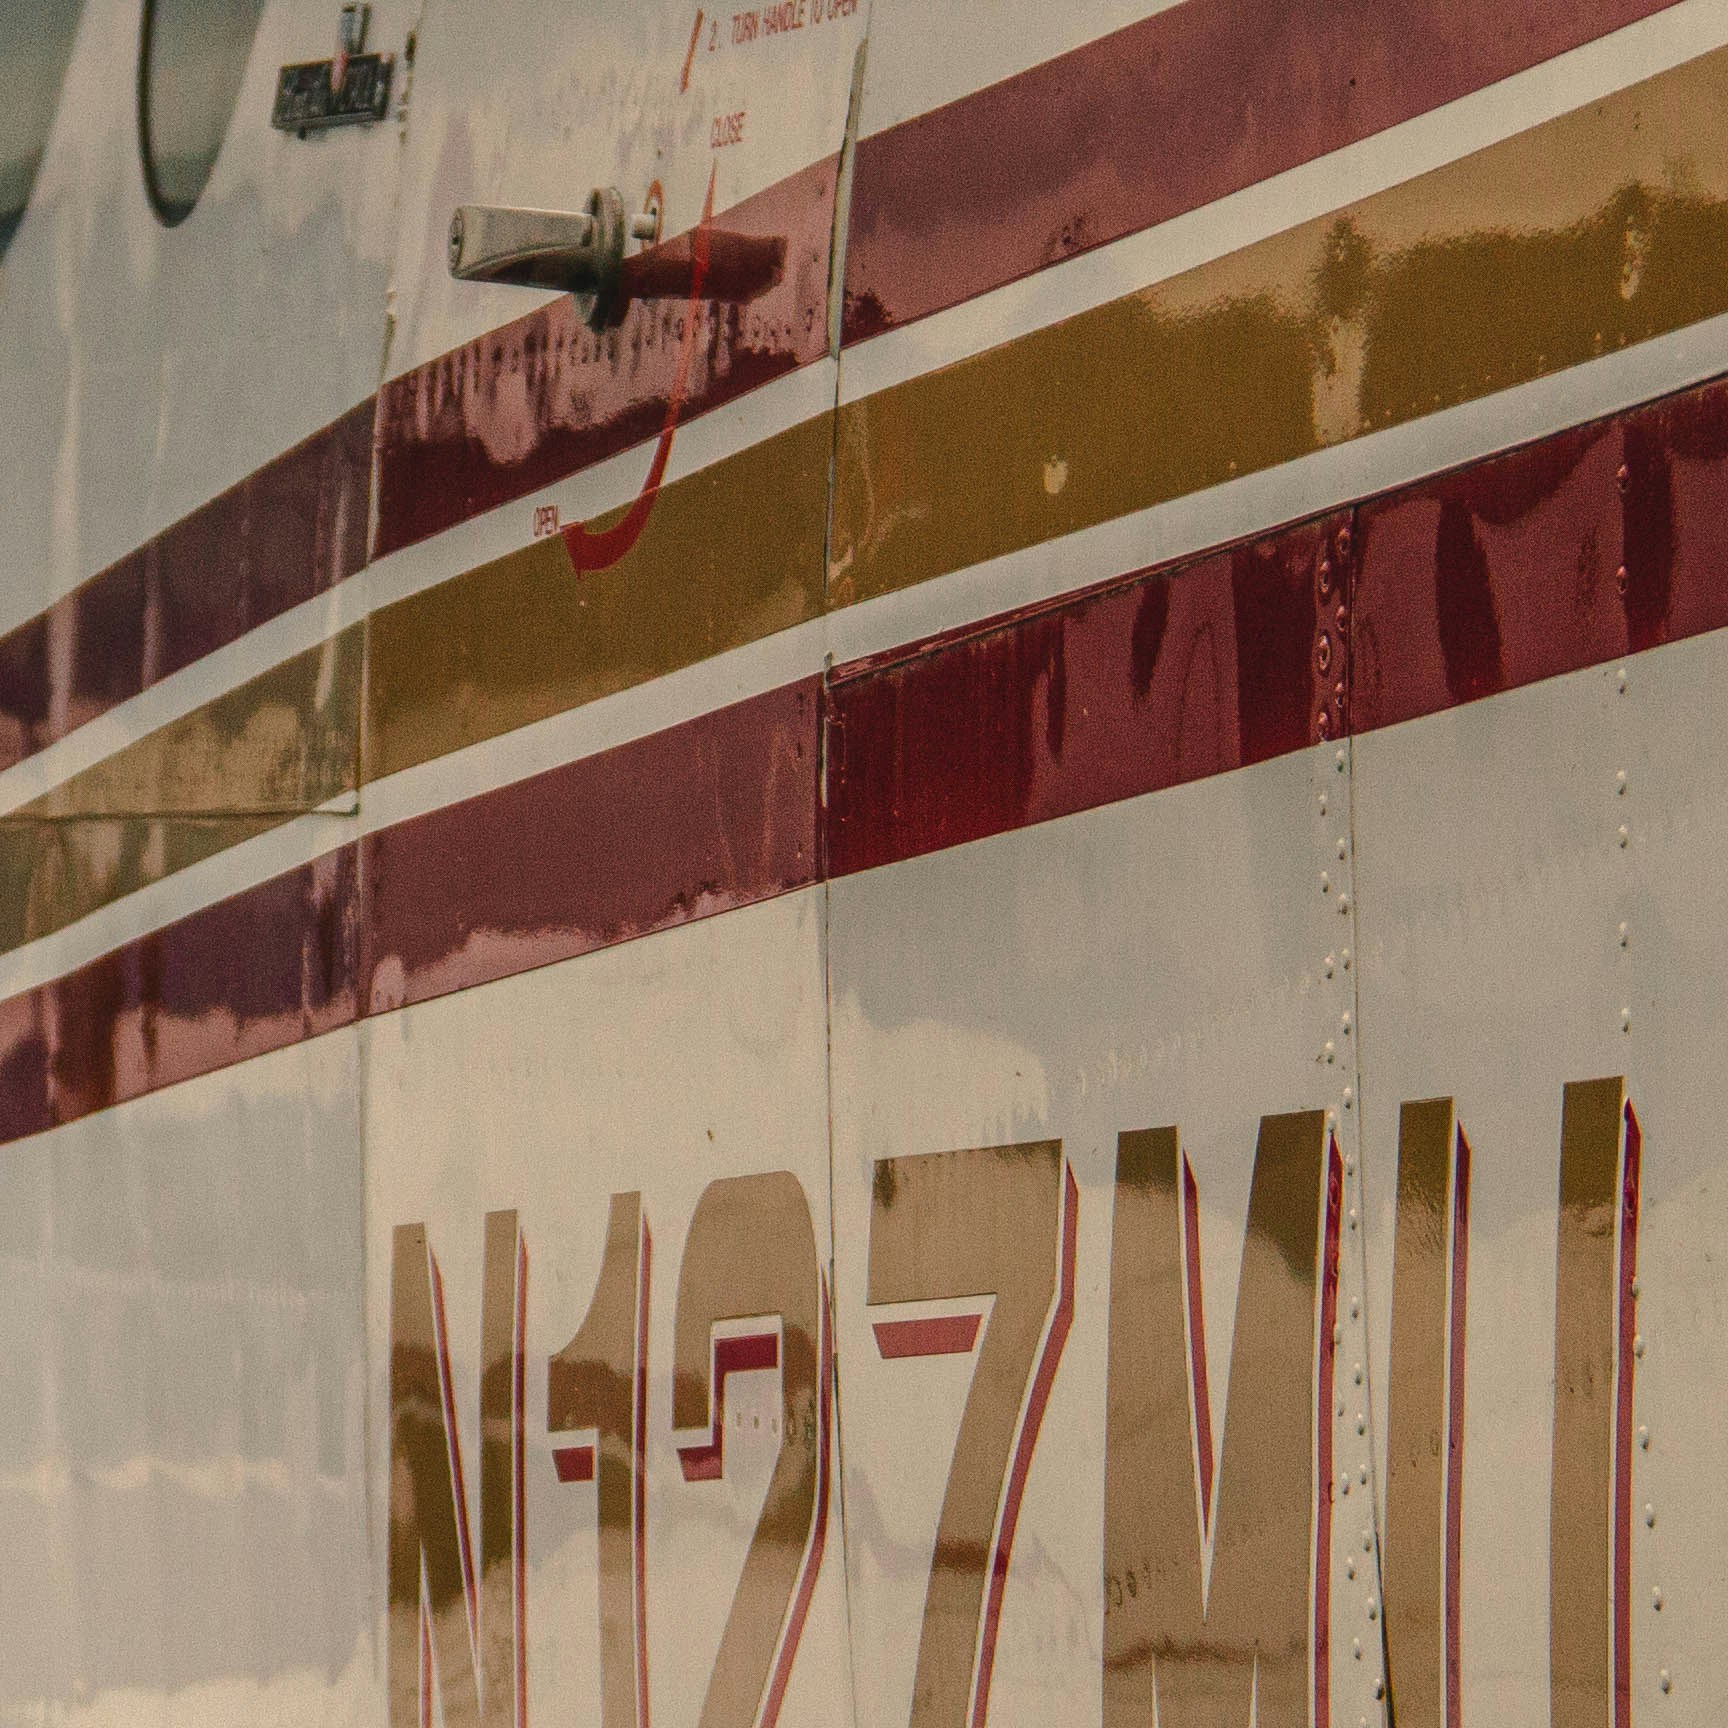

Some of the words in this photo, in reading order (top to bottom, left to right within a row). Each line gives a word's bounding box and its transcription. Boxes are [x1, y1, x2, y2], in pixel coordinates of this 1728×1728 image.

[731, 11, 760, 44] TURN
[763, 0, 804, 36] HANDLE
[710, 111, 747, 149] CLOSE
[533, 504, 559, 537] OPEN
